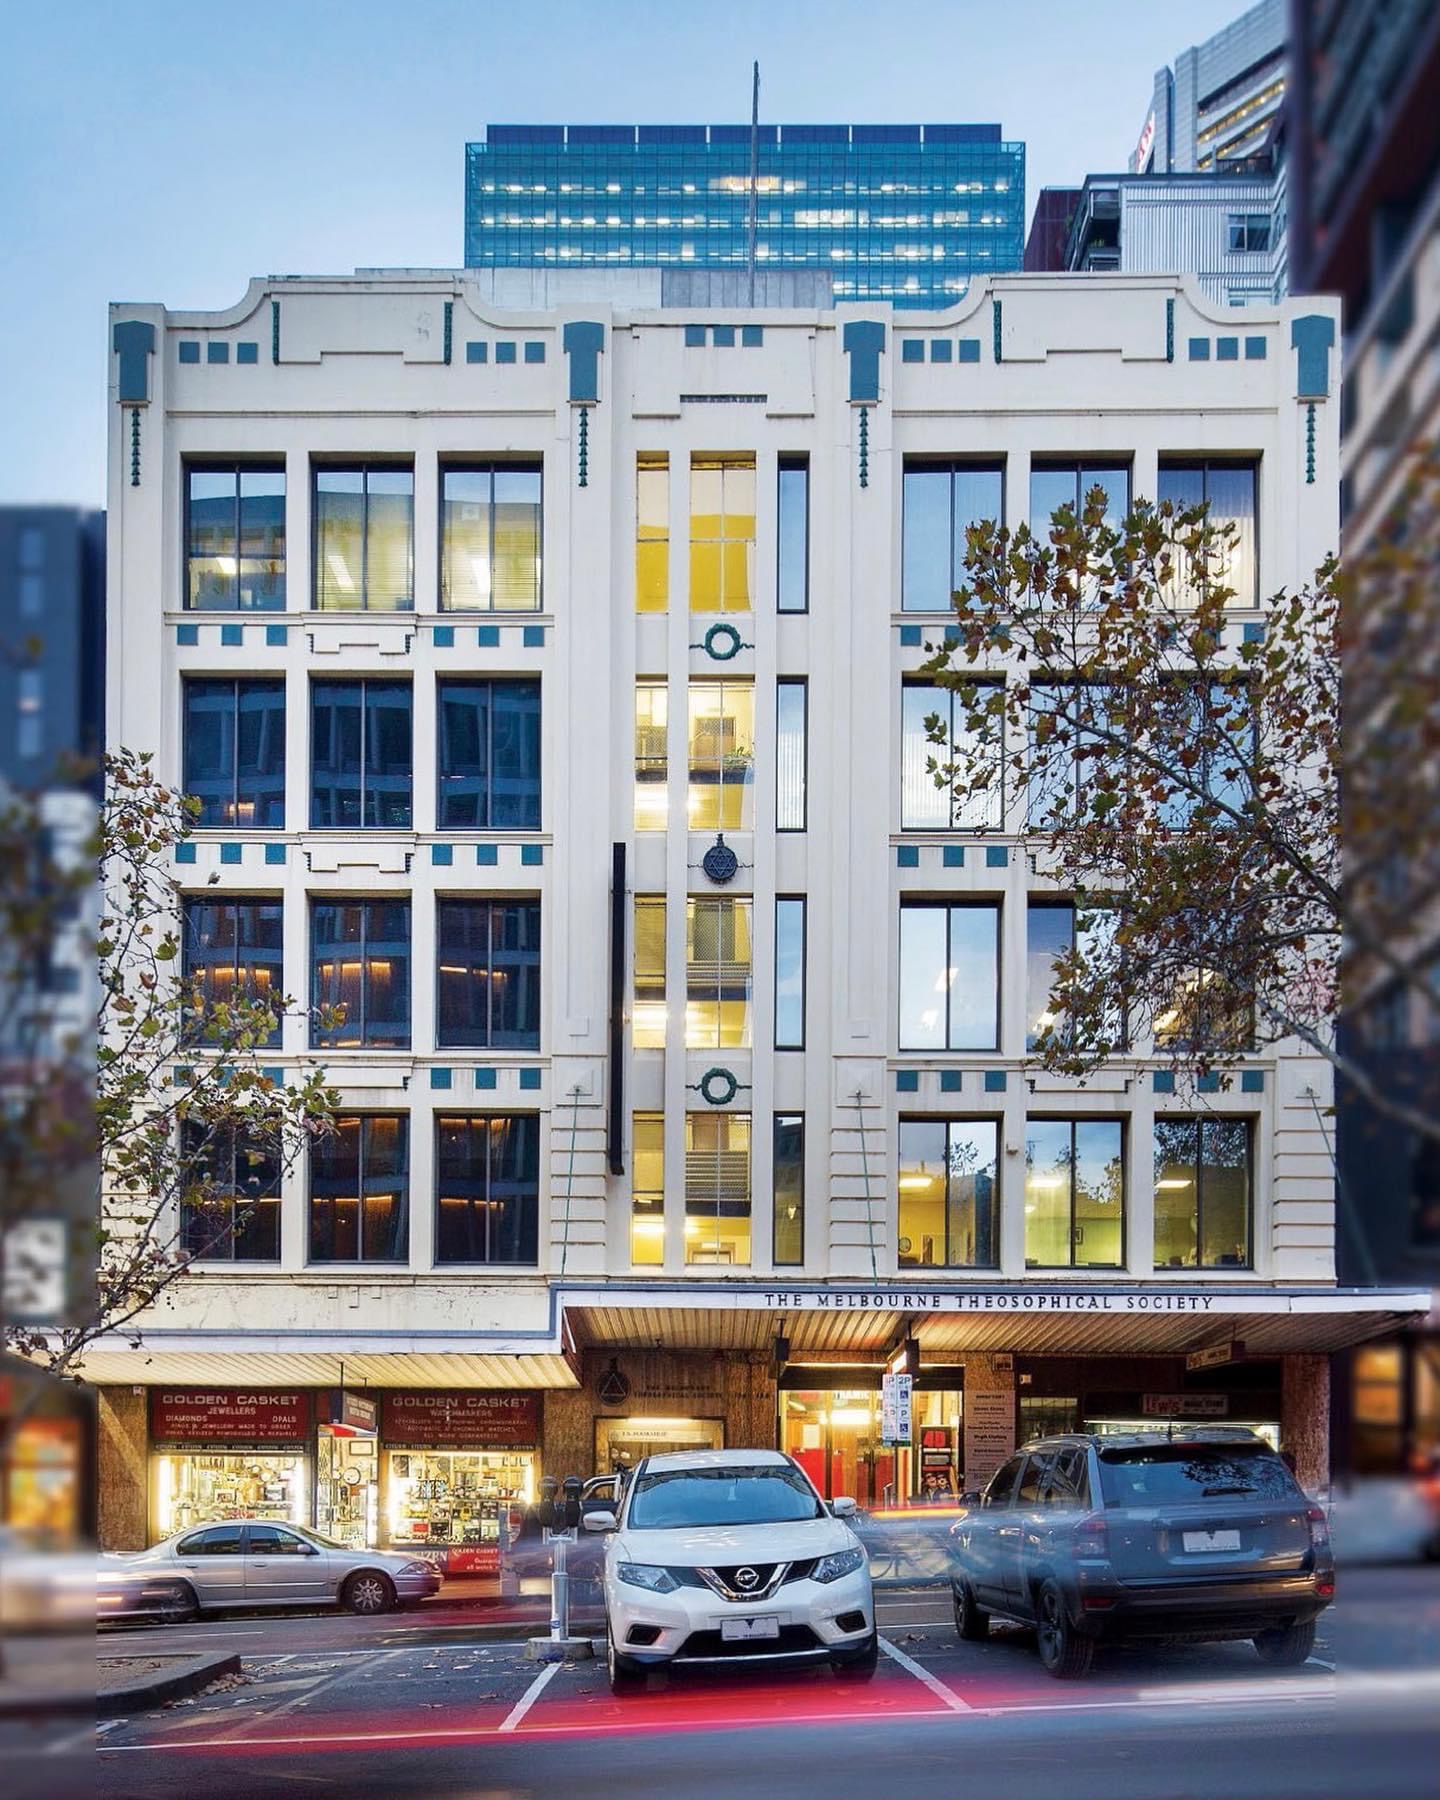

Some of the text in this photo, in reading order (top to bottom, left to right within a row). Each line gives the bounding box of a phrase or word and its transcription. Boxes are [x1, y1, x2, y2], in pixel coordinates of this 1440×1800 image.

[765, 1294, 1214, 1310] THE MELBOURNE THEOSOPHICAL SOCIETY
[898, 1376, 911, 1384] 2P
[162, 1394, 299, 1406] GOLDEN CASKET
[392, 1397, 529, 1408] GOLDEN CASKET
[207, 1407, 257, 1416] JEWELLERS
[430, 1409, 493, 1417] WATCHMAKERS
